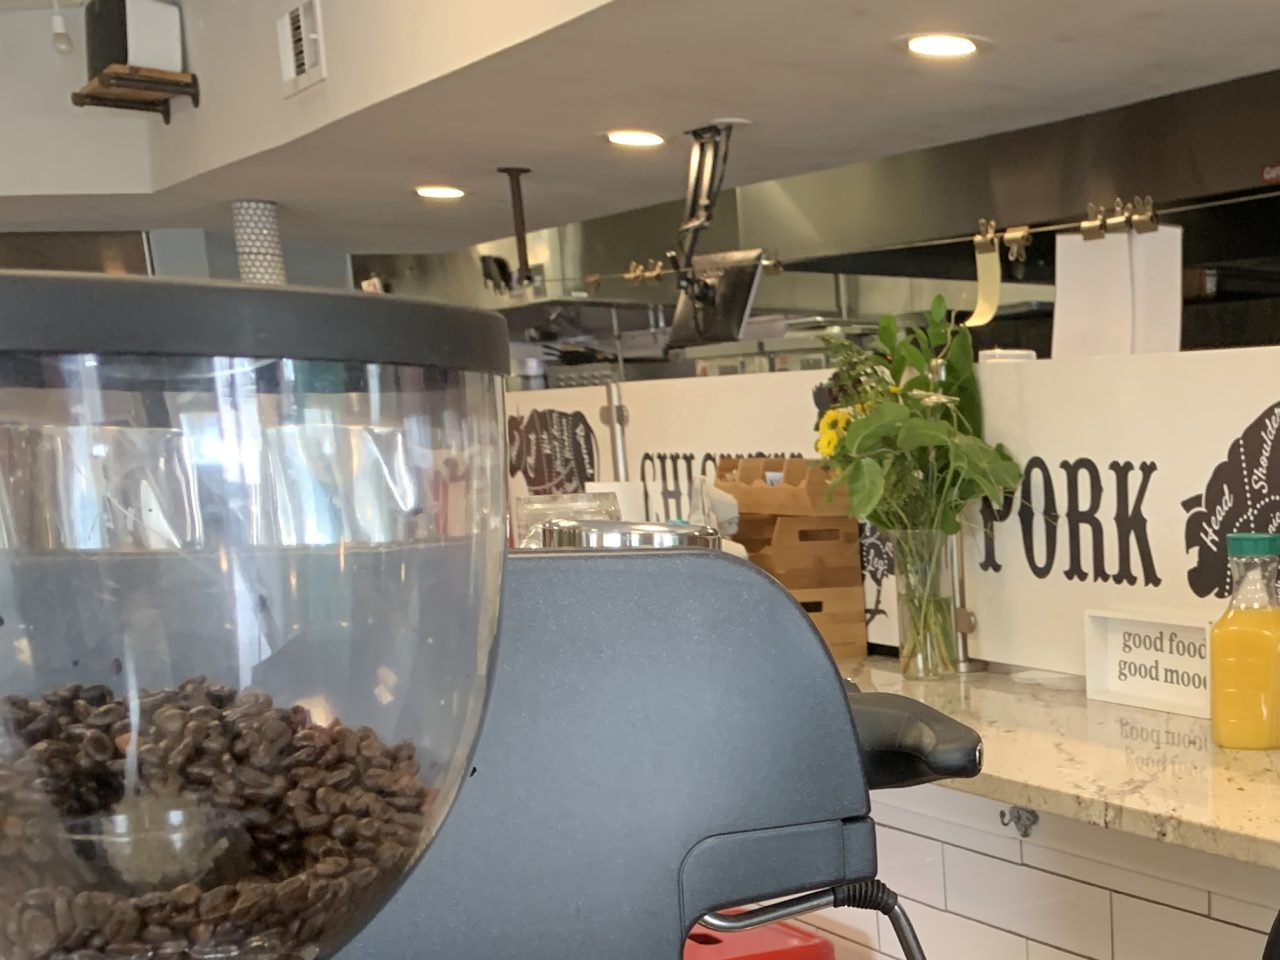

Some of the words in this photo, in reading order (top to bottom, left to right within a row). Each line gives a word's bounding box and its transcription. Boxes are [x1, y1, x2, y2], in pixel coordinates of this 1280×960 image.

[979, 456, 1163, 588] PORK
[1200, 483, 1234, 552] Head
[1122, 631, 1164, 654] good
[1118, 660, 1160, 682] good
